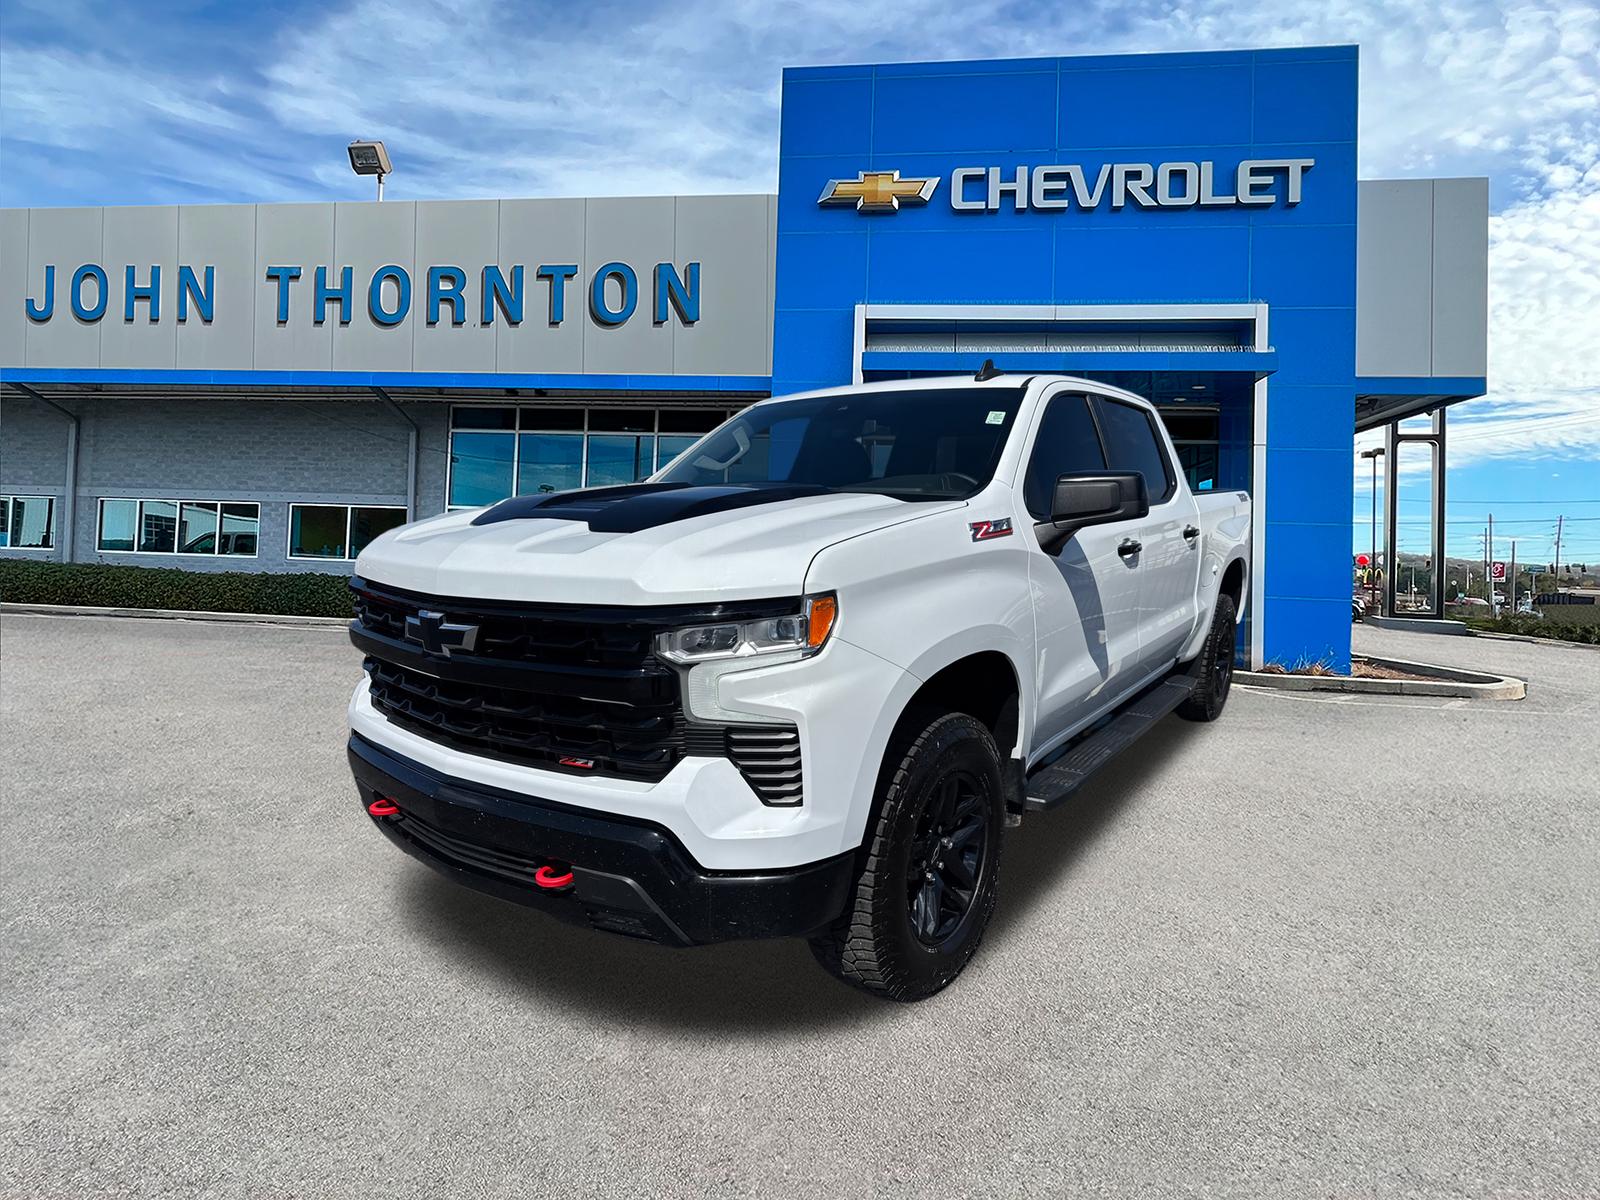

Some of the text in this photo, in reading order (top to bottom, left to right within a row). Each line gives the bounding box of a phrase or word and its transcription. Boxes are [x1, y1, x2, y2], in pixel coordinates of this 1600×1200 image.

[950, 157, 1315, 212] CHEVROLET
[25, 261, 702, 328] JOHN THORNTON
